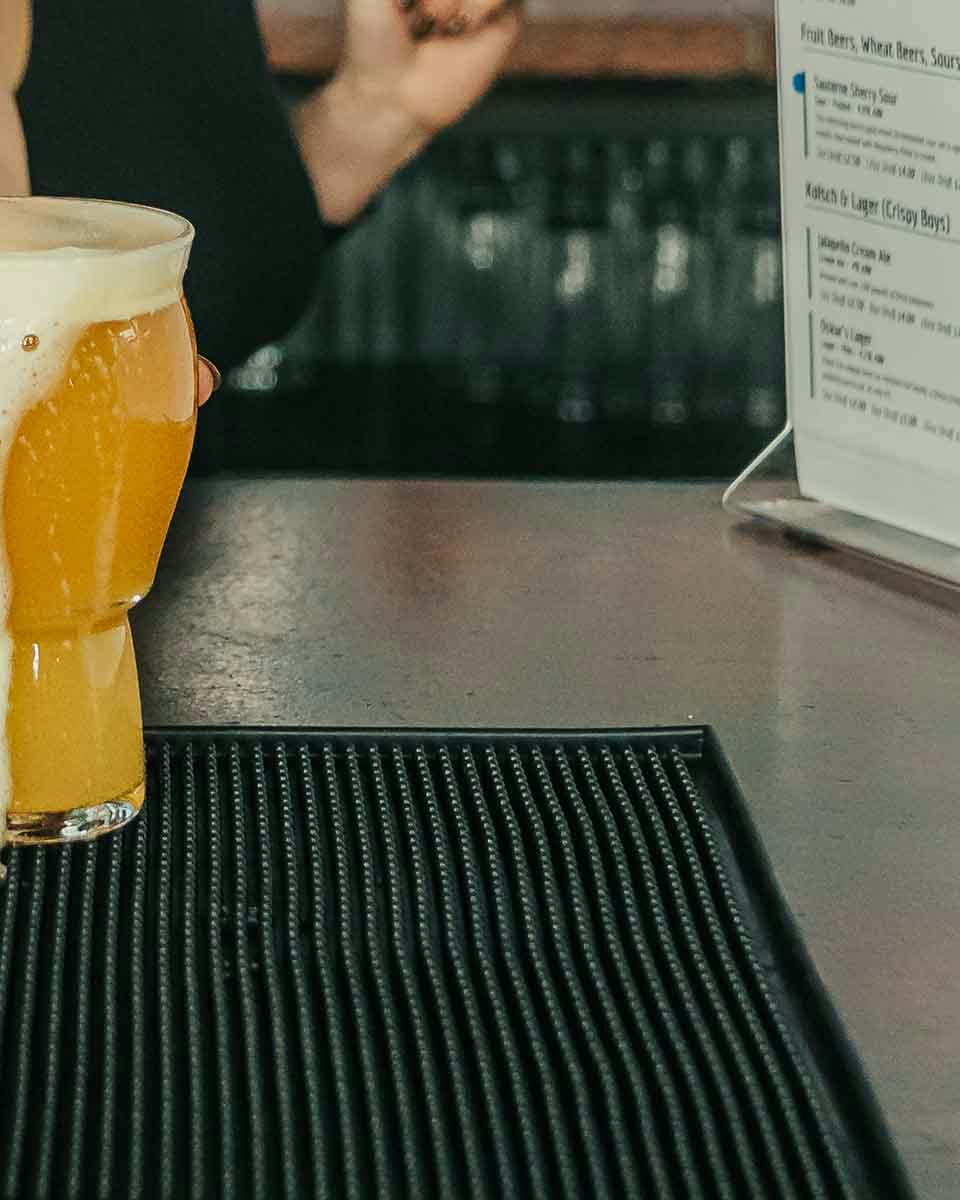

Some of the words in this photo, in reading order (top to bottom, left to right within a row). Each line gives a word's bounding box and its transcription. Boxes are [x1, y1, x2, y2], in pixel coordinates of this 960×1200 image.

[800, 22, 825, 46] Fruit
[860, 35, 893, 58] Wheat
[851, 191, 879, 217] Lager
[881, 198, 918, 230] (Crispy
[920, 208, 951, 234] Boys)
